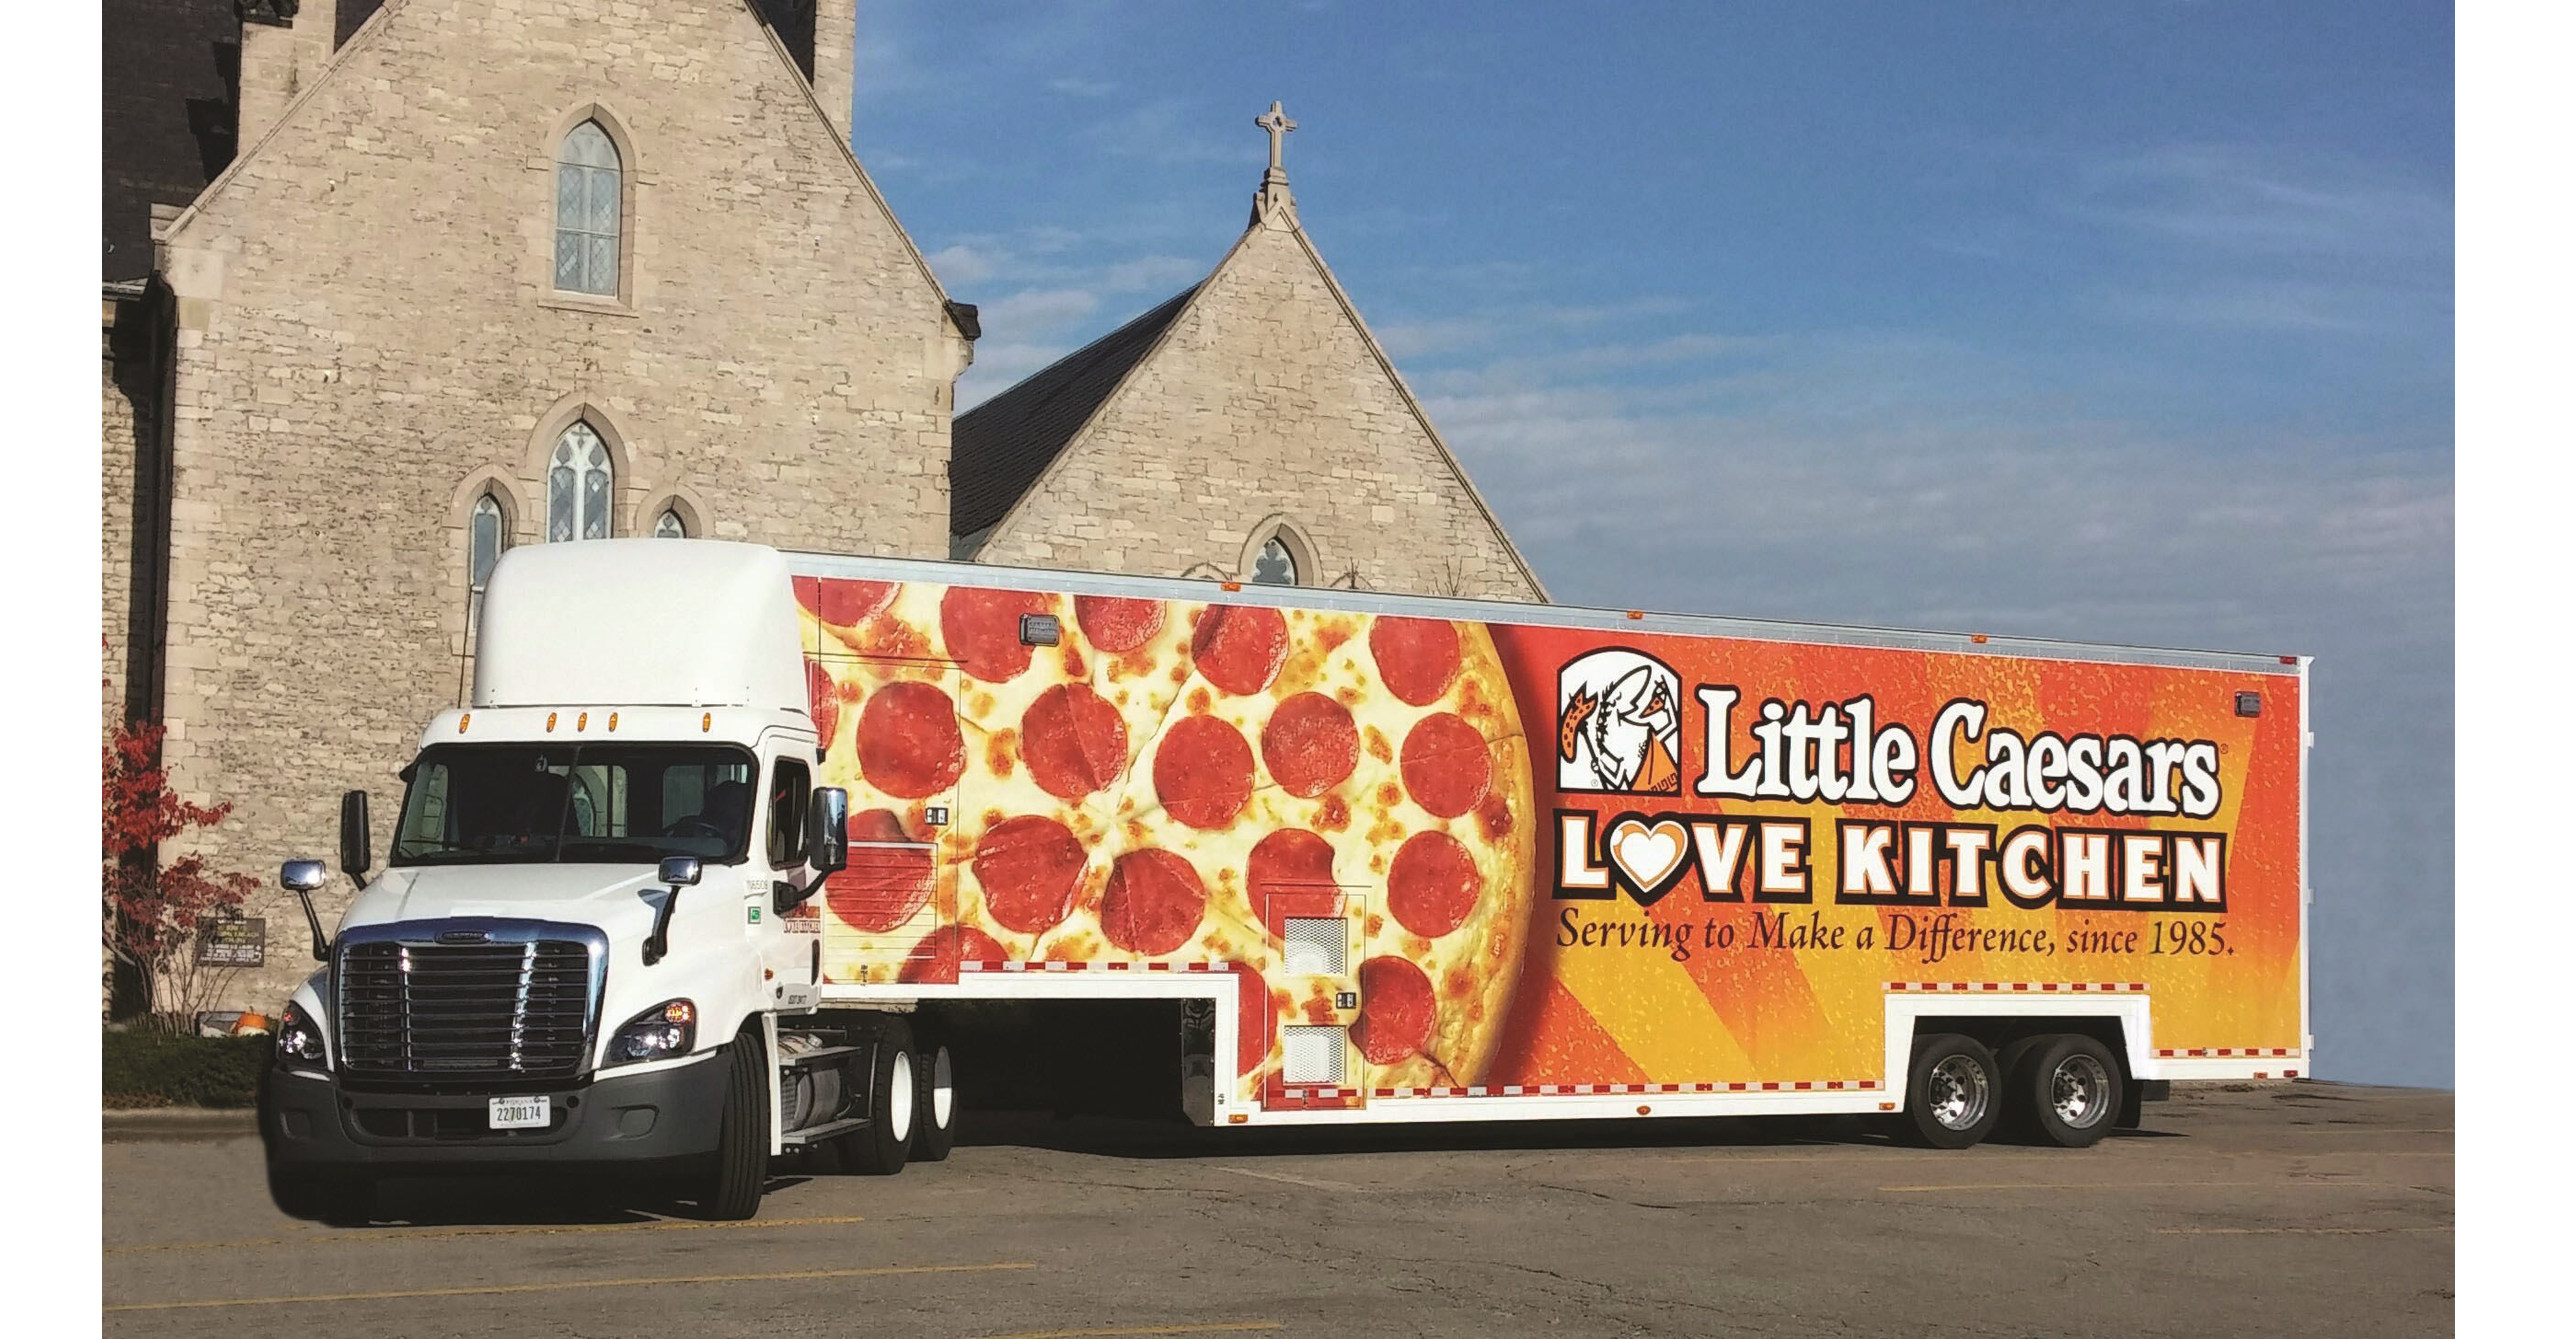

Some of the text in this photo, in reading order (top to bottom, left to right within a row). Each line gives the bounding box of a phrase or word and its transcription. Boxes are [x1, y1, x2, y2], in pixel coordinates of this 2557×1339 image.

[1696, 686, 2221, 819] Little Caesars
[1841, 823, 2222, 903] KITCHEN
[1556, 907, 2235, 964] Serving to Make a Difference, since 1985.
[497, 1106, 541, 1121] 2270174
